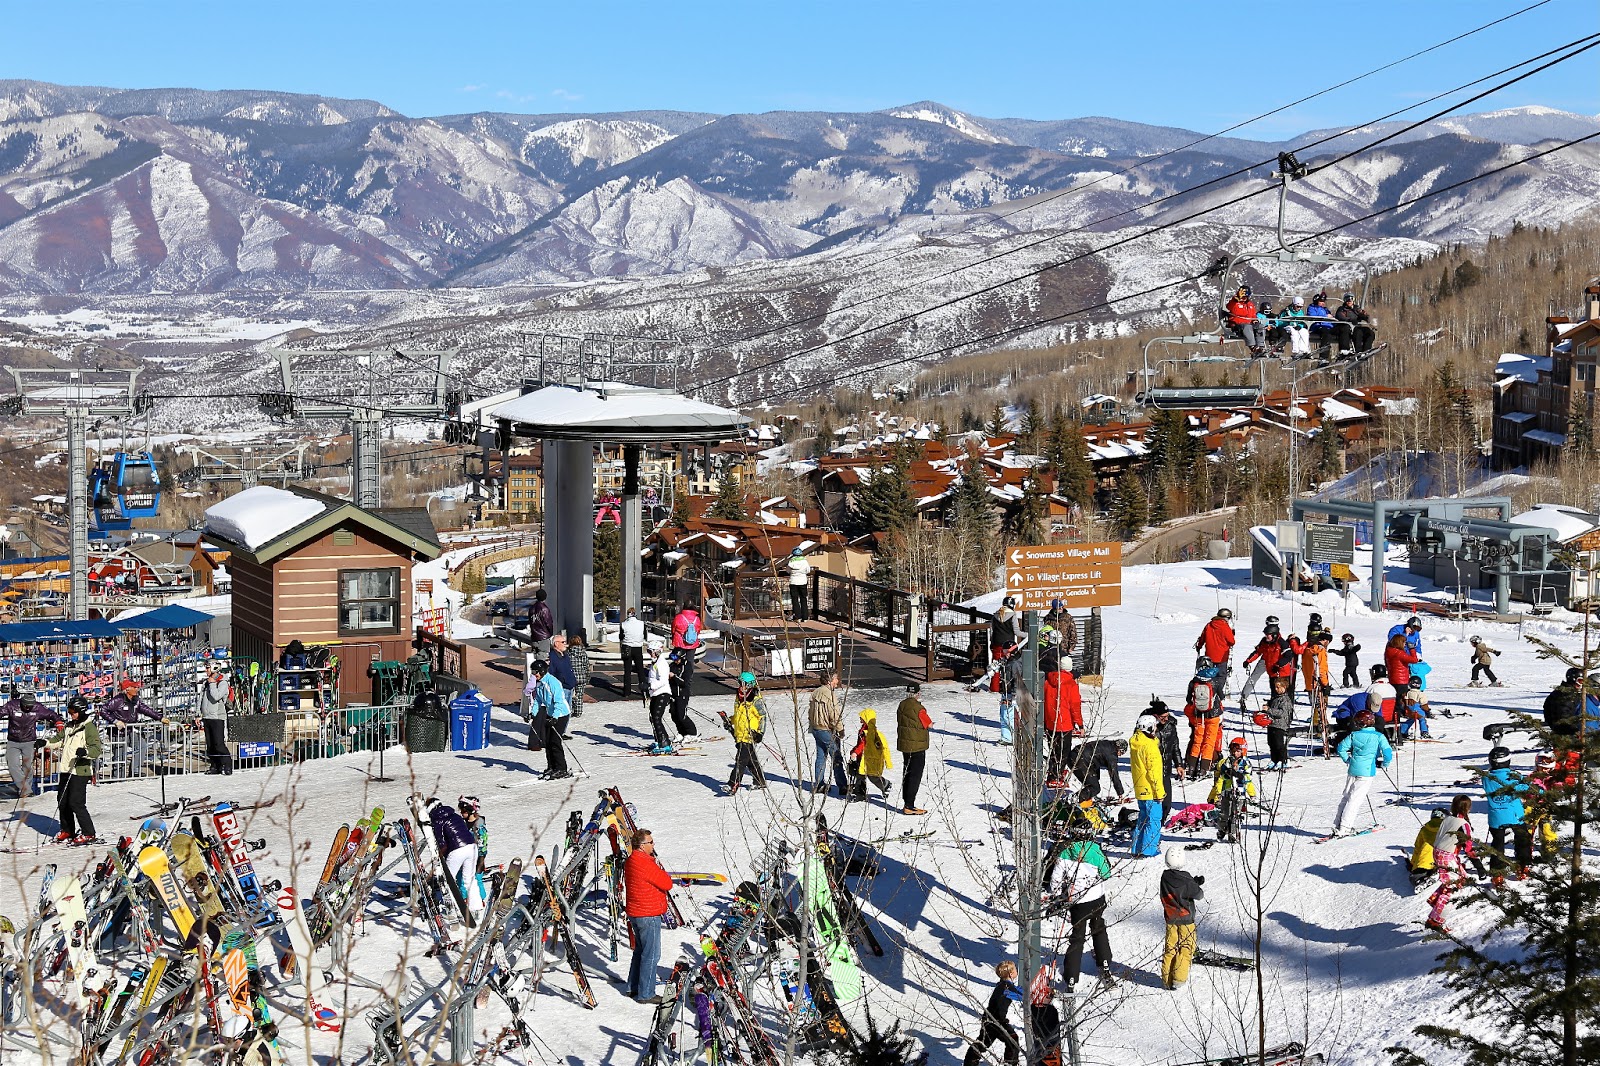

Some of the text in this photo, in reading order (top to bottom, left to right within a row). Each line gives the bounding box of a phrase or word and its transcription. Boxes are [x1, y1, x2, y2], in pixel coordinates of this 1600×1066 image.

[1026, 547, 1110, 559] Snowmass Village Mall
[1026, 570, 1101, 582] To Village Express Lift
[1046, 589, 1064, 598] Camp
[1066, 588, 1090, 597] Gondola
[1091, 587, 1096, 595] &
[218, 813, 249, 864] RIDE
[160, 873, 181, 911] FLOW
